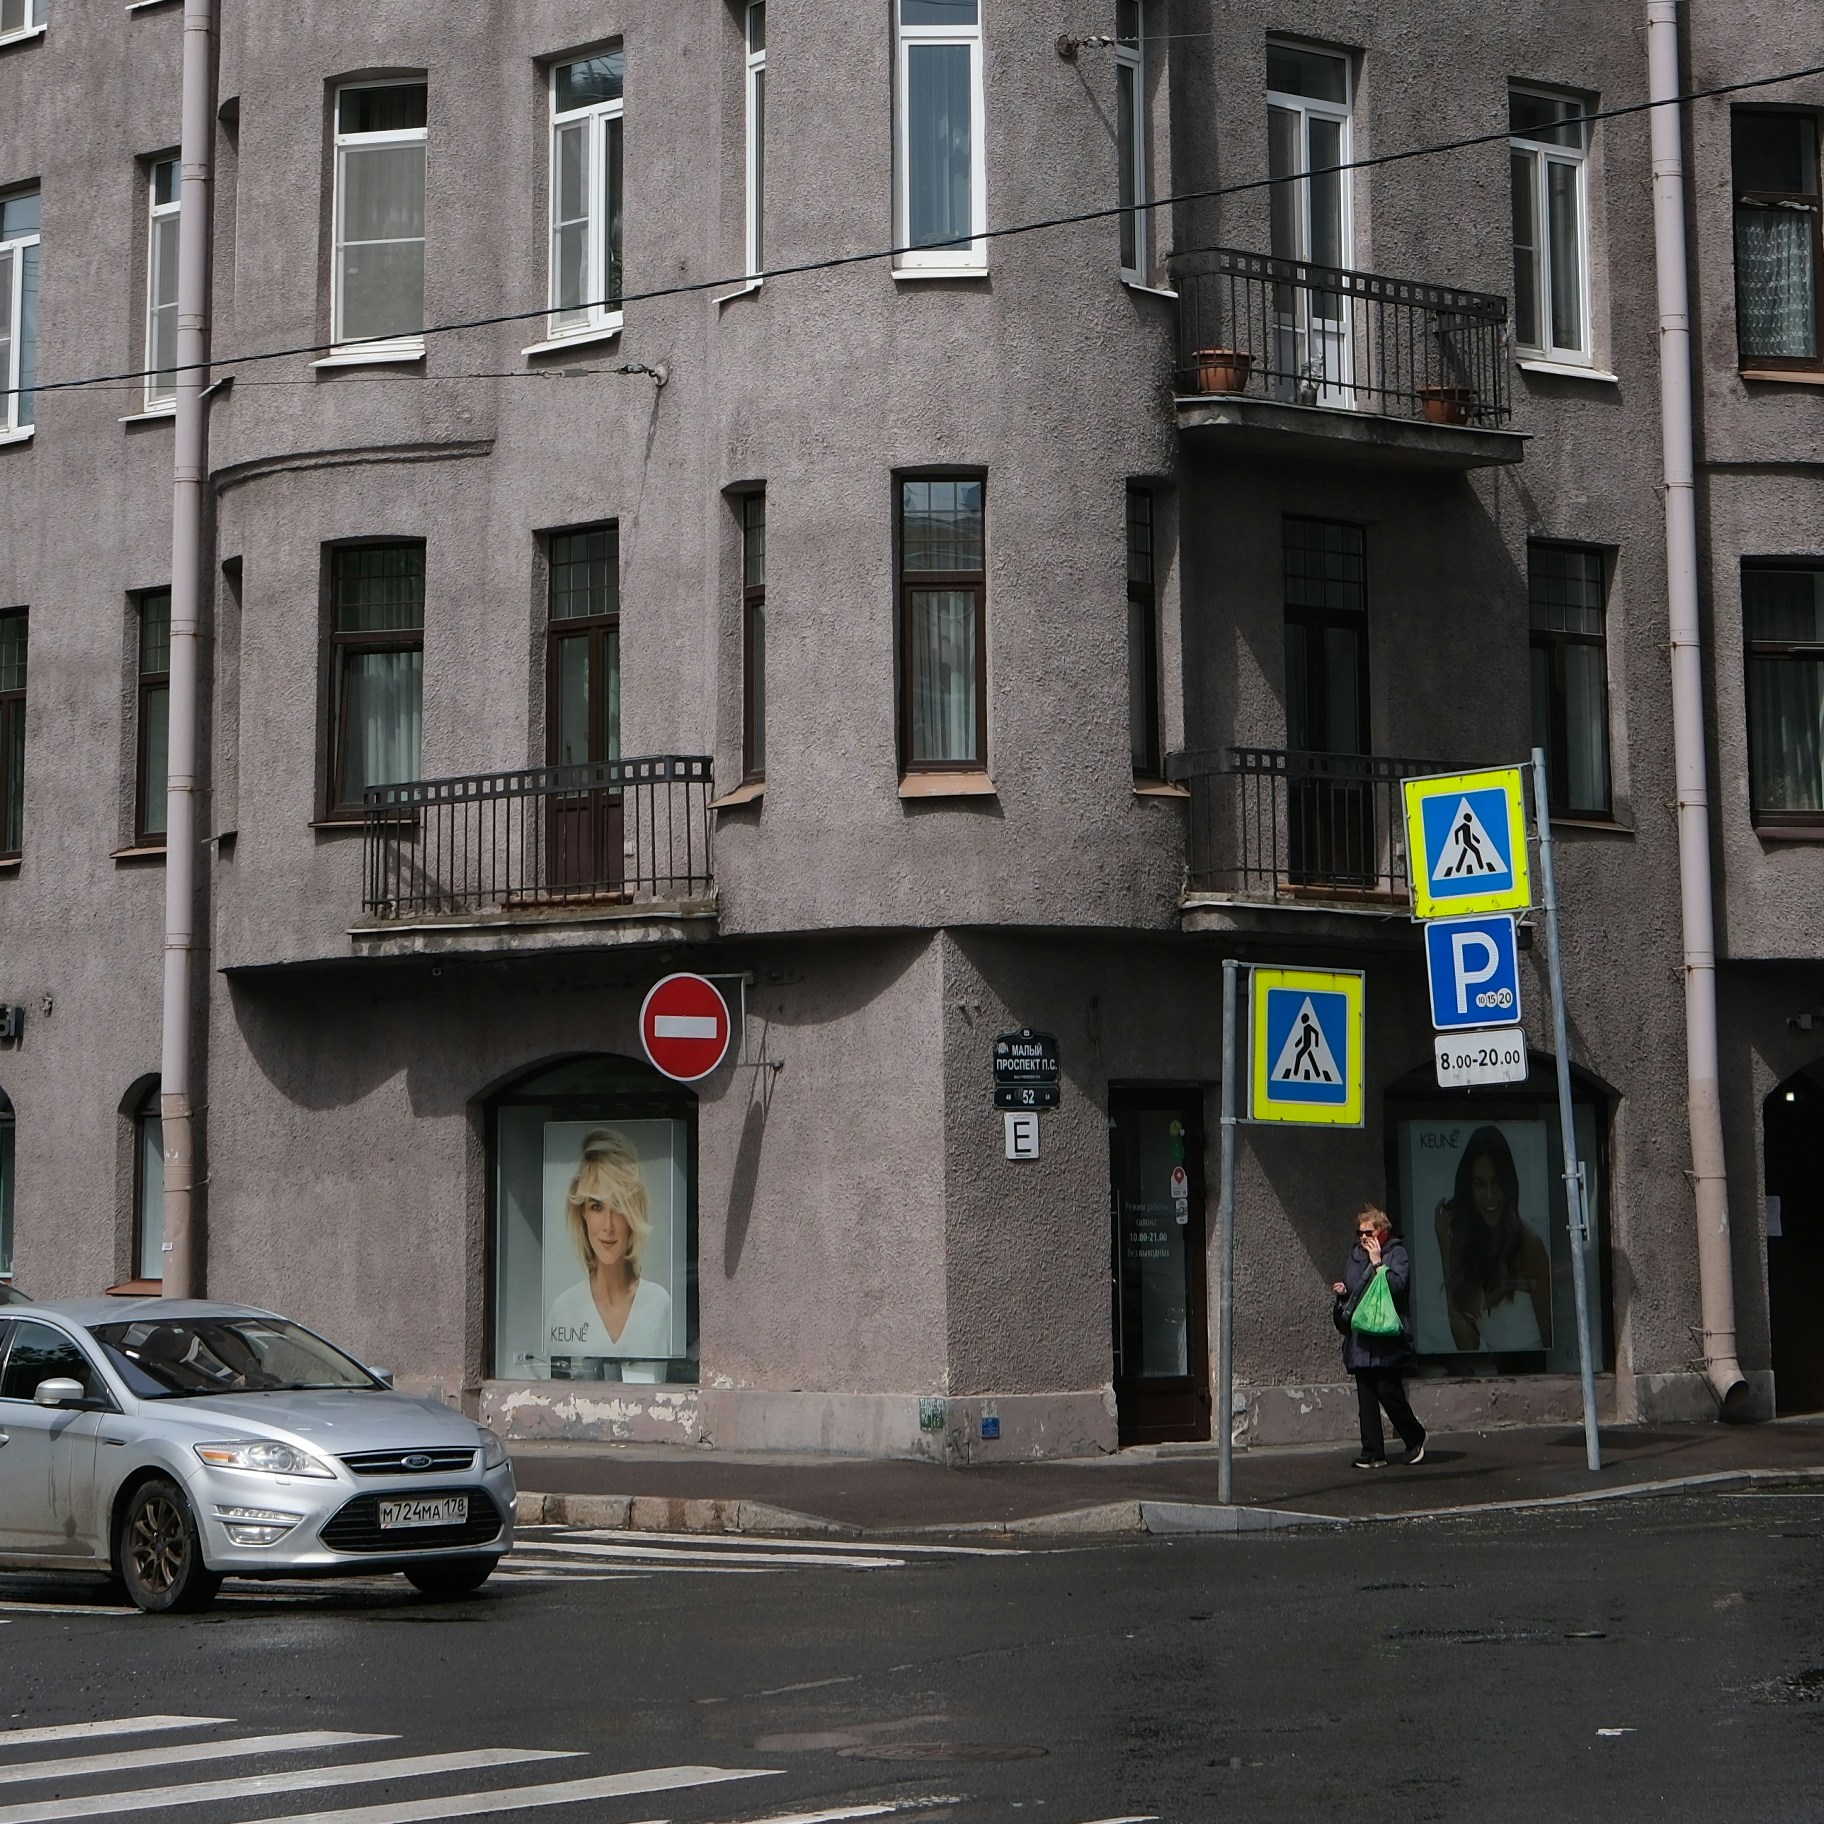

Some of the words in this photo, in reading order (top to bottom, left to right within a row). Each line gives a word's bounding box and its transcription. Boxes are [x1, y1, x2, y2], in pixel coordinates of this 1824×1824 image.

[1452, 932, 1499, 1013] P
[1478, 996, 1485, 1004] 10
[1487, 994, 1496, 1004] 15
[1499, 992, 1511, 1004] 20
[1011, 1043, 1043, 1056] МАЛЫЙ
[997, 1058, 1040, 1070] ПРОСПЕКТ
[1042, 1058, 1057, 1070] П.С.
[1440, 1048, 1520, 1070] 8.00-20.00
[1022, 1089, 1034, 1104] 52
[1420, 1132, 1458, 1149] KEUNE
[551, 1325, 588, 1342] KEUNE
[383, 1502, 441, 1522] М724МА
[443, 1498, 464, 1514] 178
